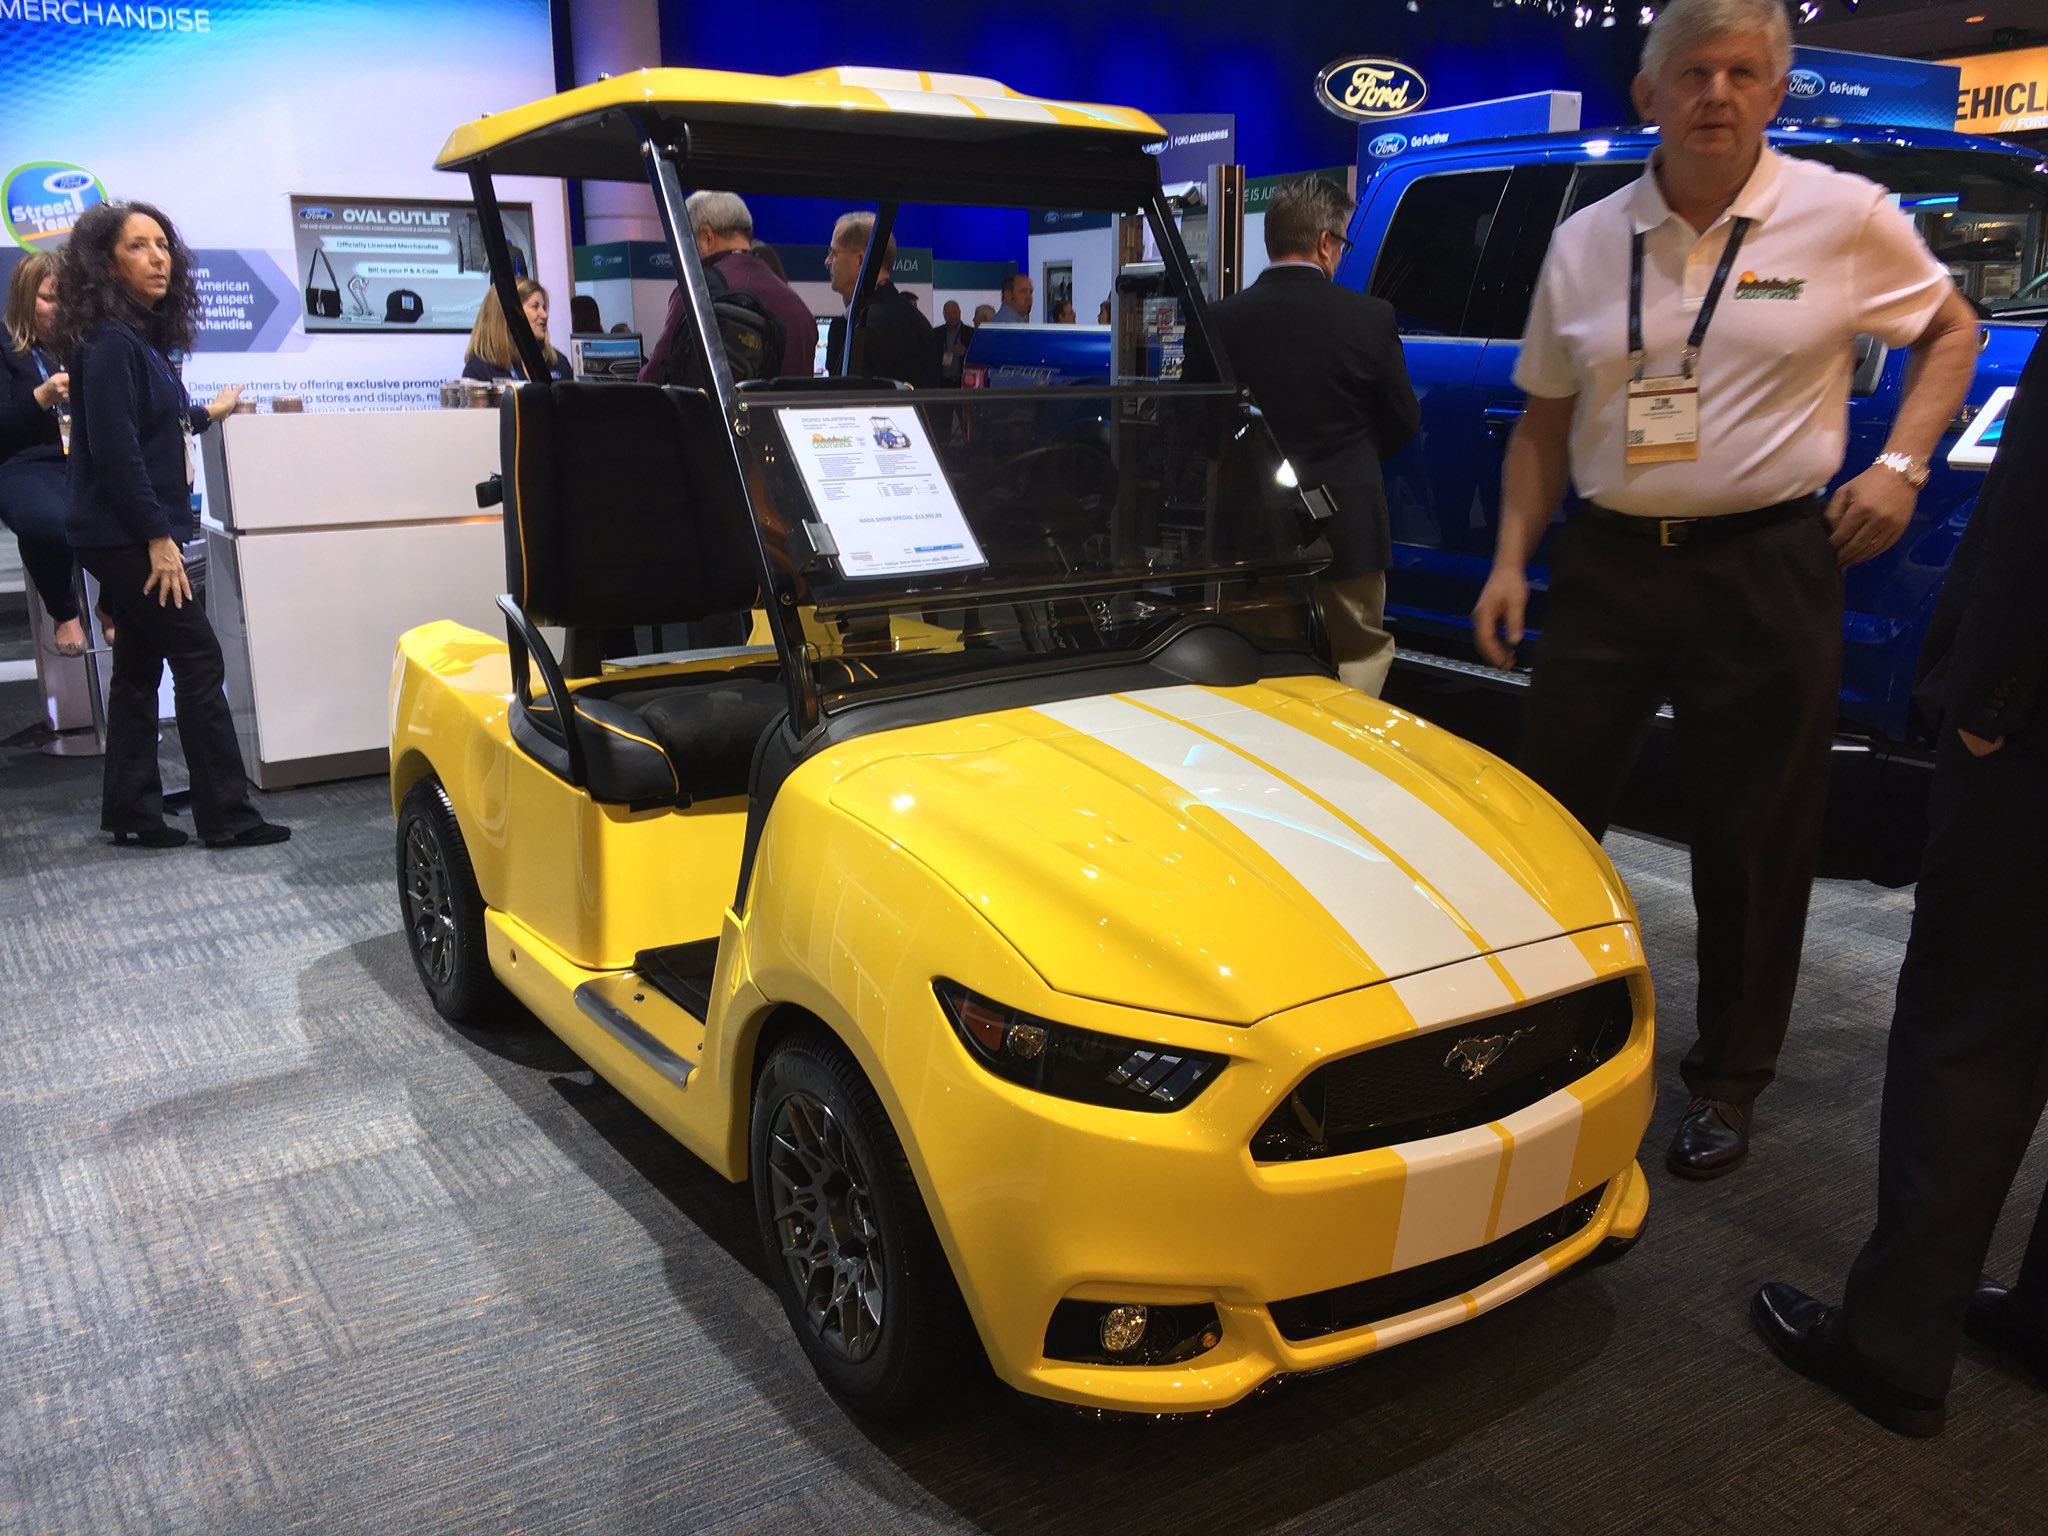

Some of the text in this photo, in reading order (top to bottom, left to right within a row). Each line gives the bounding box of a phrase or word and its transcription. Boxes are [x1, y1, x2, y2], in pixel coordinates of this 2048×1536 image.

[0, 0, 212, 33] MERCHANDISE
[1345, 67, 1409, 109] Ford
[1789, 75, 1818, 95] Ford
[1829, 80, 1870, 97] Go Further
[1956, 81, 2048, 120] EHICL
[1174, 135, 1190, 146] FORD
[1189, 128, 1229, 144] ACCESSORIES
[1411, 131, 1450, 148] Go Further
[1375, 138, 1400, 155] Ford
[1250, 187, 1260, 201] IS
[12, 199, 73, 222] Street
[342, 208, 387, 225] OVAL
[388, 209, 450, 226] OUTLET
[336, 241, 367, 250] Officially
[367, 242, 397, 250] Licensed
[368, 266, 379, 274] Bill
[380, 267, 387, 275] to
[893, 259, 919, 271] ADA
[195, 280, 250, 292] American
[215, 293, 254, 306] aspect
[205, 305, 245, 319] selling
[198, 318, 253, 330] chandise
[283, 379, 298, 391] by
[300, 379, 343, 391] offering
[346, 378, 399, 390] exclusive
[315, 393, 351, 404] stores
[353, 391, 375, 403] and
[377, 391, 425, 404] displays,
